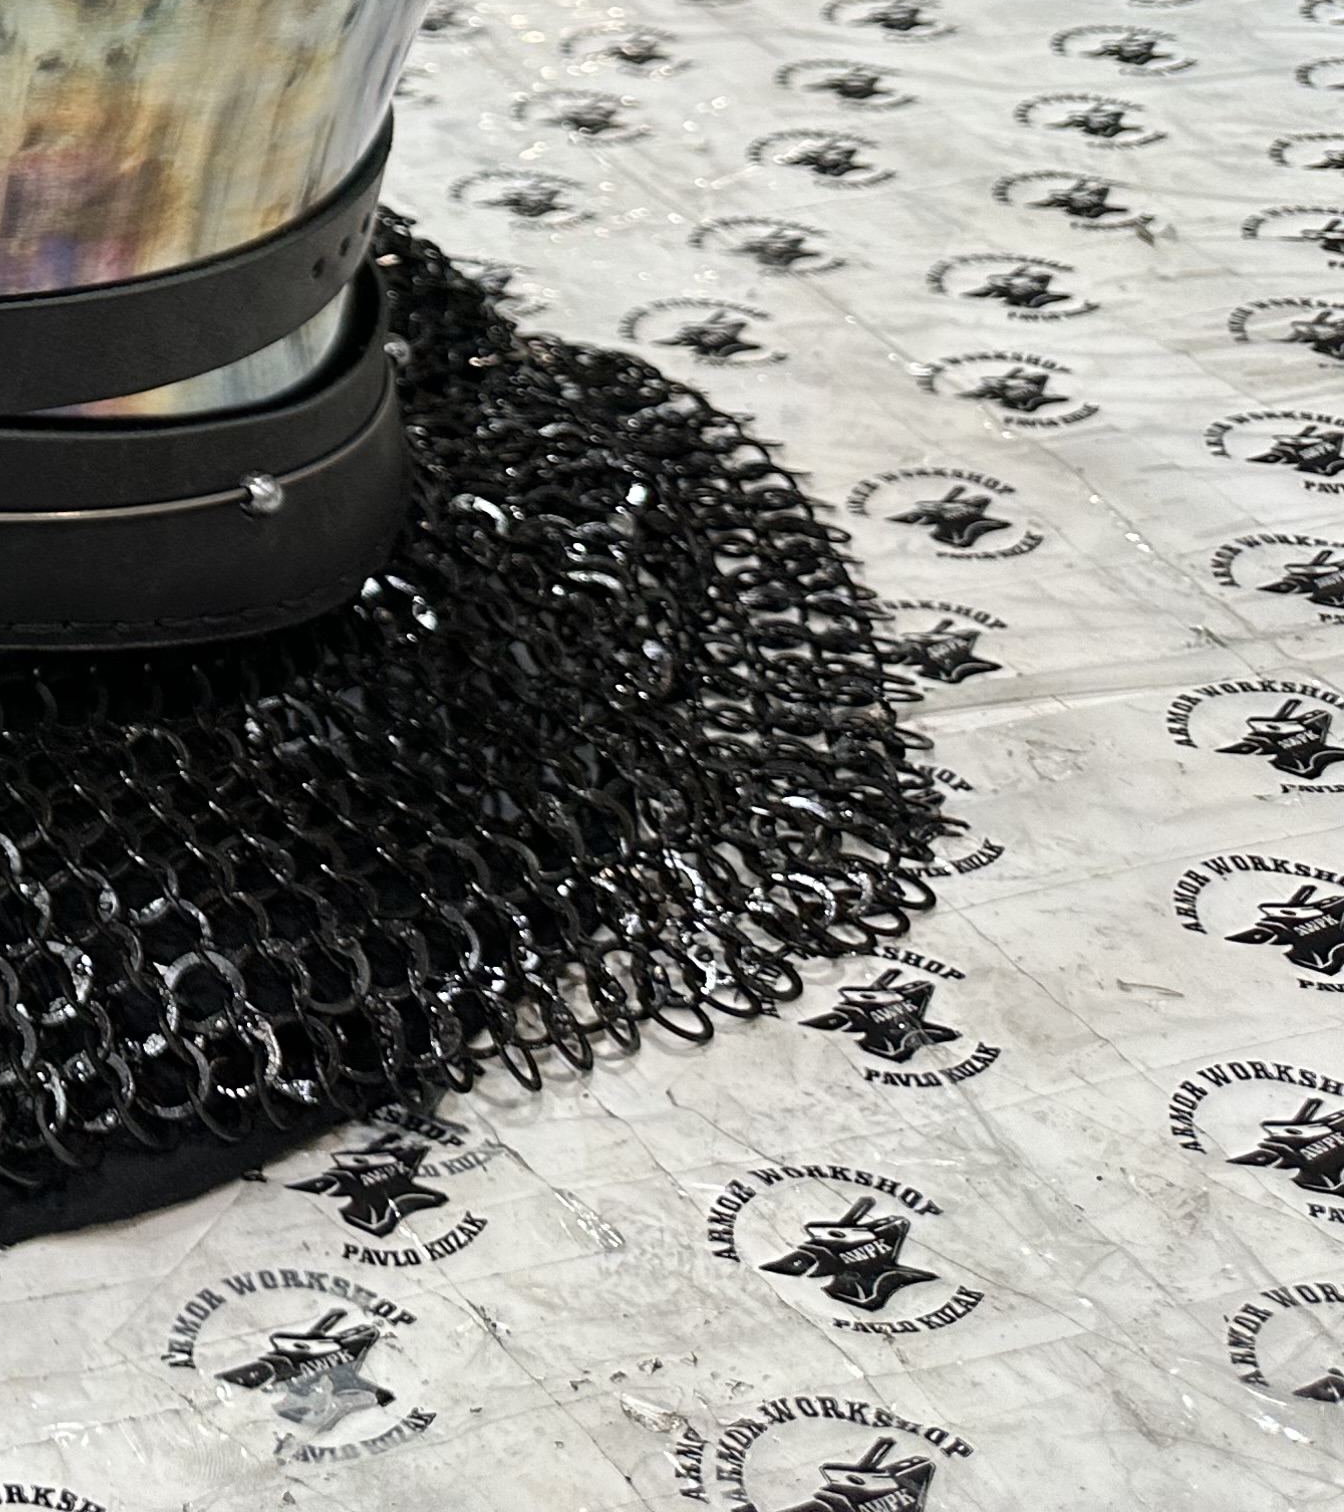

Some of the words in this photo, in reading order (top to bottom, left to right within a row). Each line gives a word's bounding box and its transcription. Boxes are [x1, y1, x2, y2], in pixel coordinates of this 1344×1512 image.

[1166, 692, 1204, 749] ARMOR
[1173, 869, 1211, 935] ARMOR
[1294, 913, 1340, 936] AWPK
[863, 1067, 943, 1087] PAVLO
[938, 1041, 1002, 1084] KOZAK
[1169, 1080, 1208, 1155] ARMOR
[707, 1179, 757, 1263] ARMOR
[748, 1164, 944, 1218] WORKSHOP
[341, 1242, 421, 1267] PAVLO
[838, 1238, 894, 1265] AWPK
[915, 1285, 986, 1330] KOZAK
[757, 1395, 975, 1459] WORKSHOP
